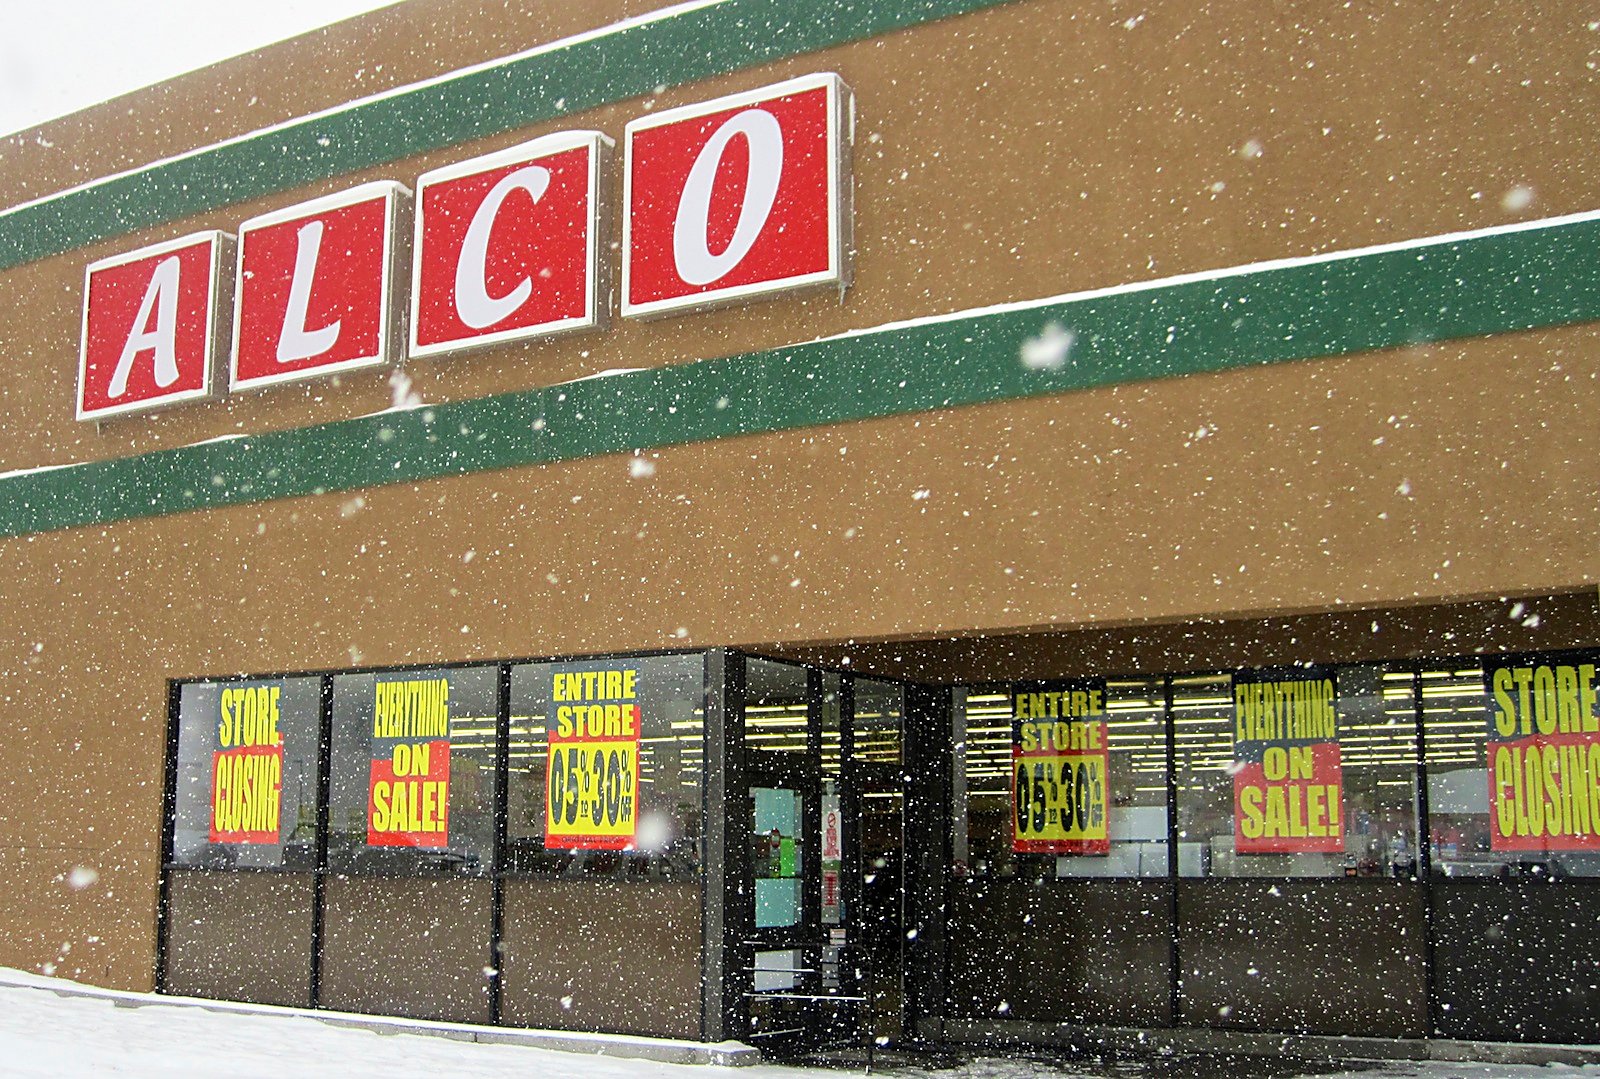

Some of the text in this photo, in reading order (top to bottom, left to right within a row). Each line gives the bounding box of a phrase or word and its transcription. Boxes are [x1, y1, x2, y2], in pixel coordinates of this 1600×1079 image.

[108, 109, 783, 398] ALCO
[374, 678, 449, 738] EVERYTHING
[553, 670, 636, 702] ENTIRE
[1015, 690, 1103, 719] ENTIRE
[1236, 678, 1335, 741] EVERYTHING
[1493, 664, 1600, 737] STORE
[219, 686, 281, 747] STORE
[557, 704, 635, 738] STORE
[1020, 721, 1102, 752] STORE
[392, 744, 430, 776] ON
[1263, 746, 1314, 781] ON
[215, 753, 281, 833] CLOSING
[373, 781, 447, 833] SALE!
[1240, 785, 1339, 839] SALE!
